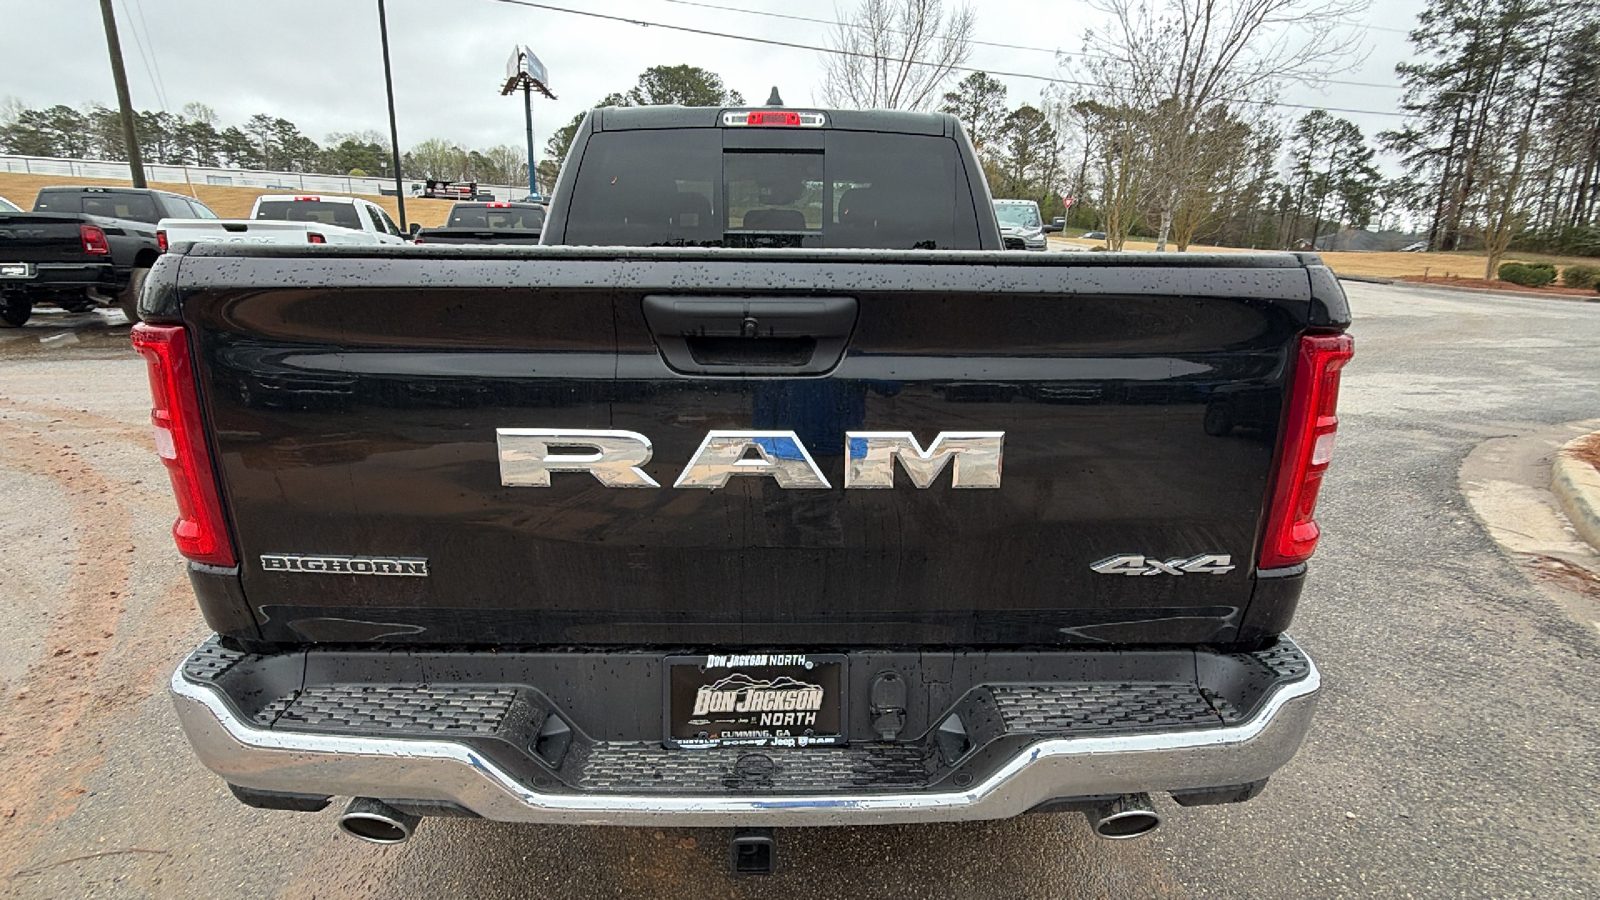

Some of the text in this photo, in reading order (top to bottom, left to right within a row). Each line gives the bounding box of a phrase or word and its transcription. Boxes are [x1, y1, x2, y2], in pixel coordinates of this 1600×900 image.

[496, 428, 1005, 489] RAM
[260, 553, 430, 577] BIGHORN
[1089, 553, 1236, 576] 4x4
[706, 654, 727, 668] DON
[768, 654, 806, 666] NORTH
[692, 688, 824, 726] DON JACKSON NORTH
[770, 736, 796, 748] Jeep
